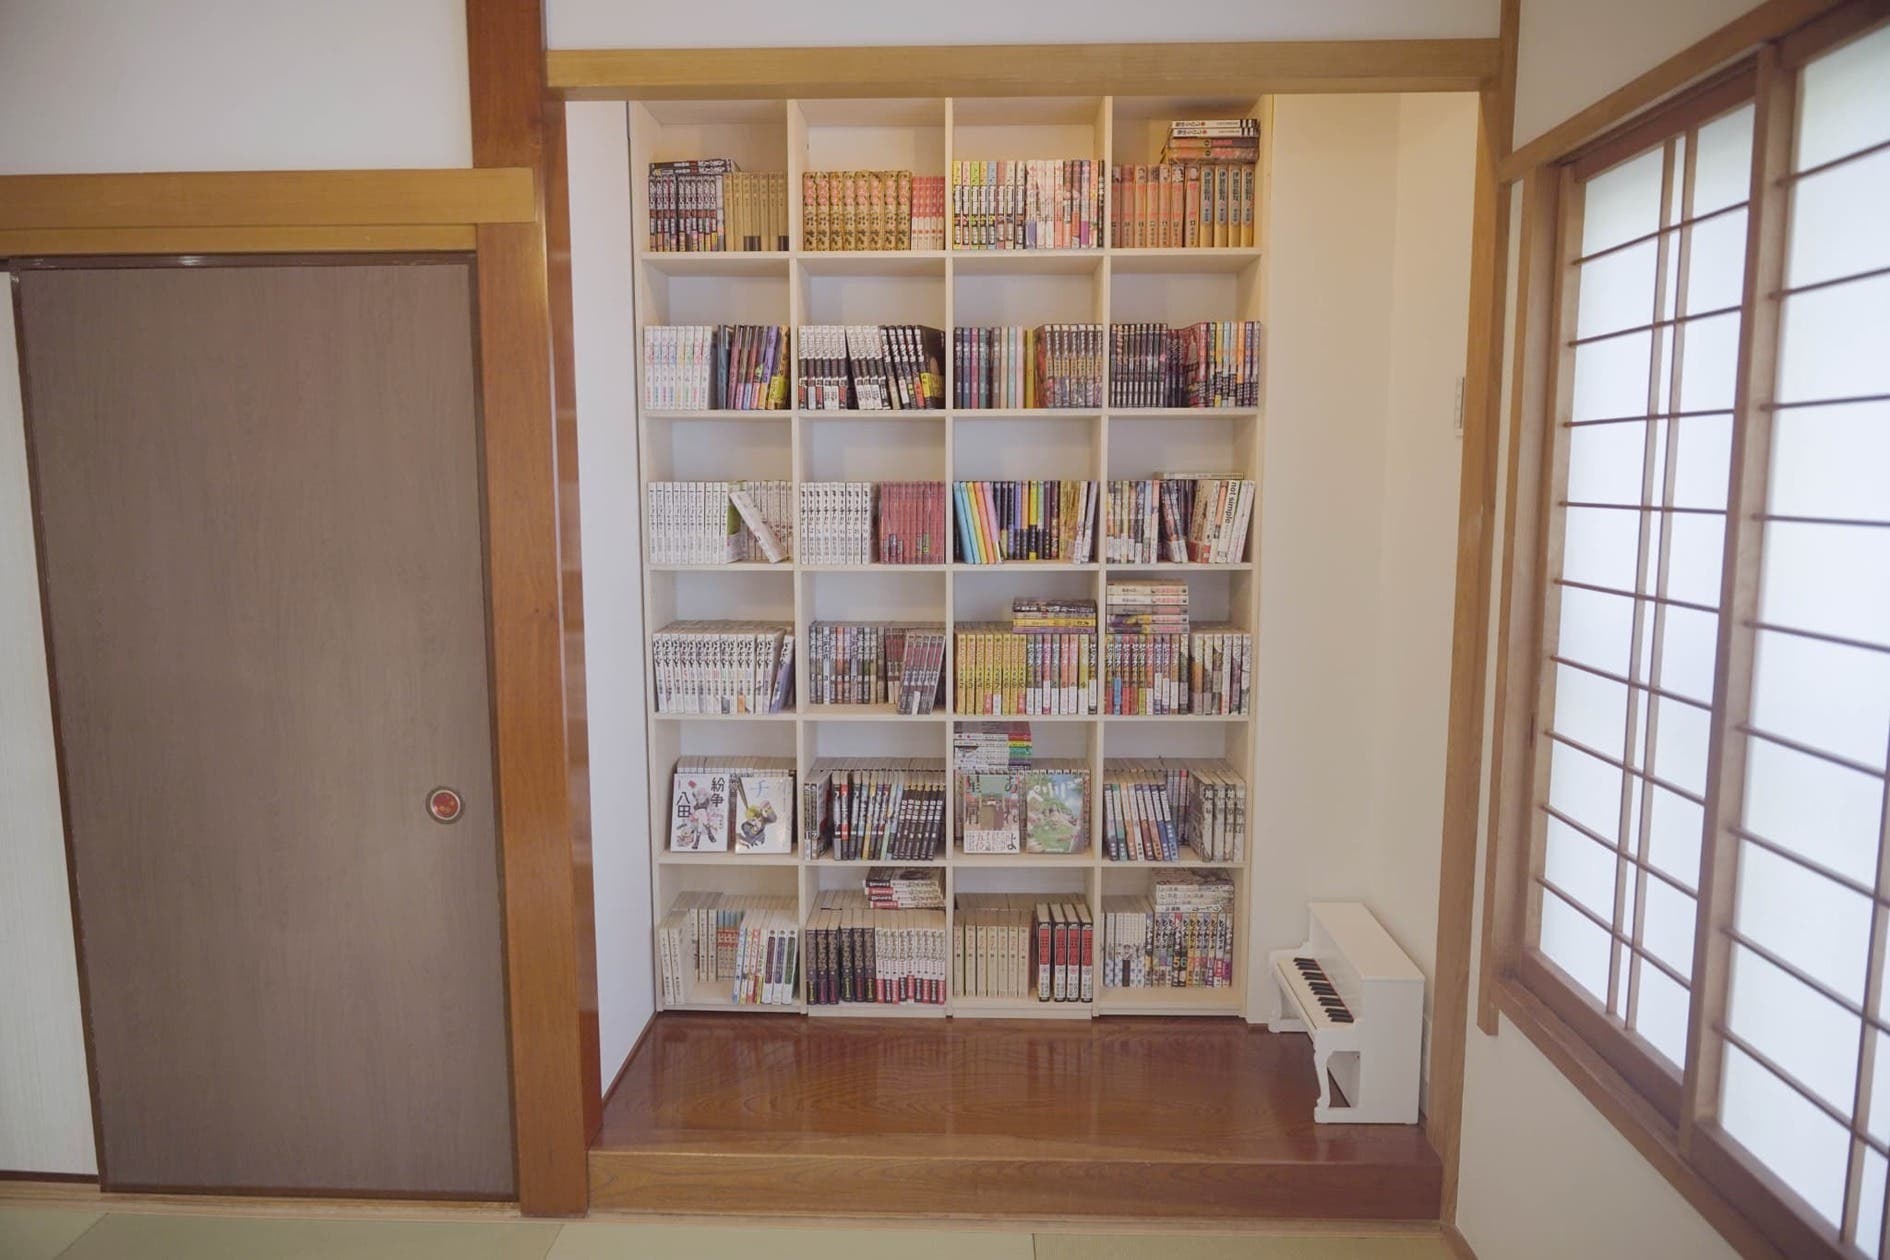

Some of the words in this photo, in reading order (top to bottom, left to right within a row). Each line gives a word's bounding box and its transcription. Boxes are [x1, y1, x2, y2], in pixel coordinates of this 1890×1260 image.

[1229, 481, 1237, 496] not
[1224, 496, 1236, 525] simple
[710, 776, 725, 808] 紛争
[676, 791, 692, 818] 八田
[1173, 956, 1180, 967] 5
[1180, 956, 1187, 967] 6
